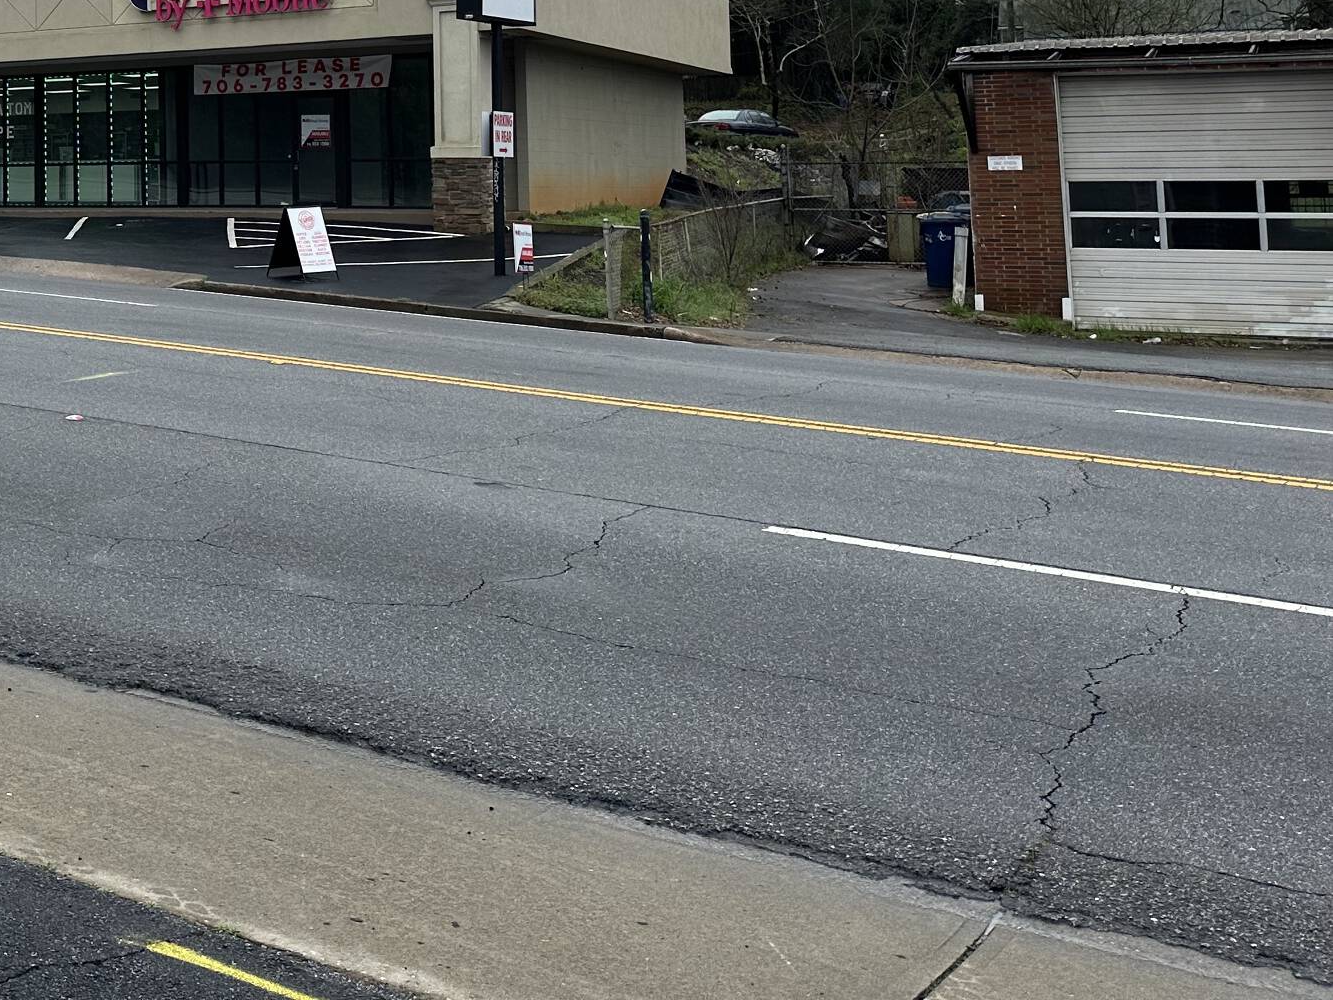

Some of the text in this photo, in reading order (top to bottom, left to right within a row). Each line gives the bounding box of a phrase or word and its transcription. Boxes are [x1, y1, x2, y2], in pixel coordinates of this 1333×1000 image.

[221, 57, 361, 78] FOR LEASE
[202, 71, 384, 94] 706-783-3270
[494, 113, 513, 127] PARKING
[495, 130, 512, 143] IN REAR
